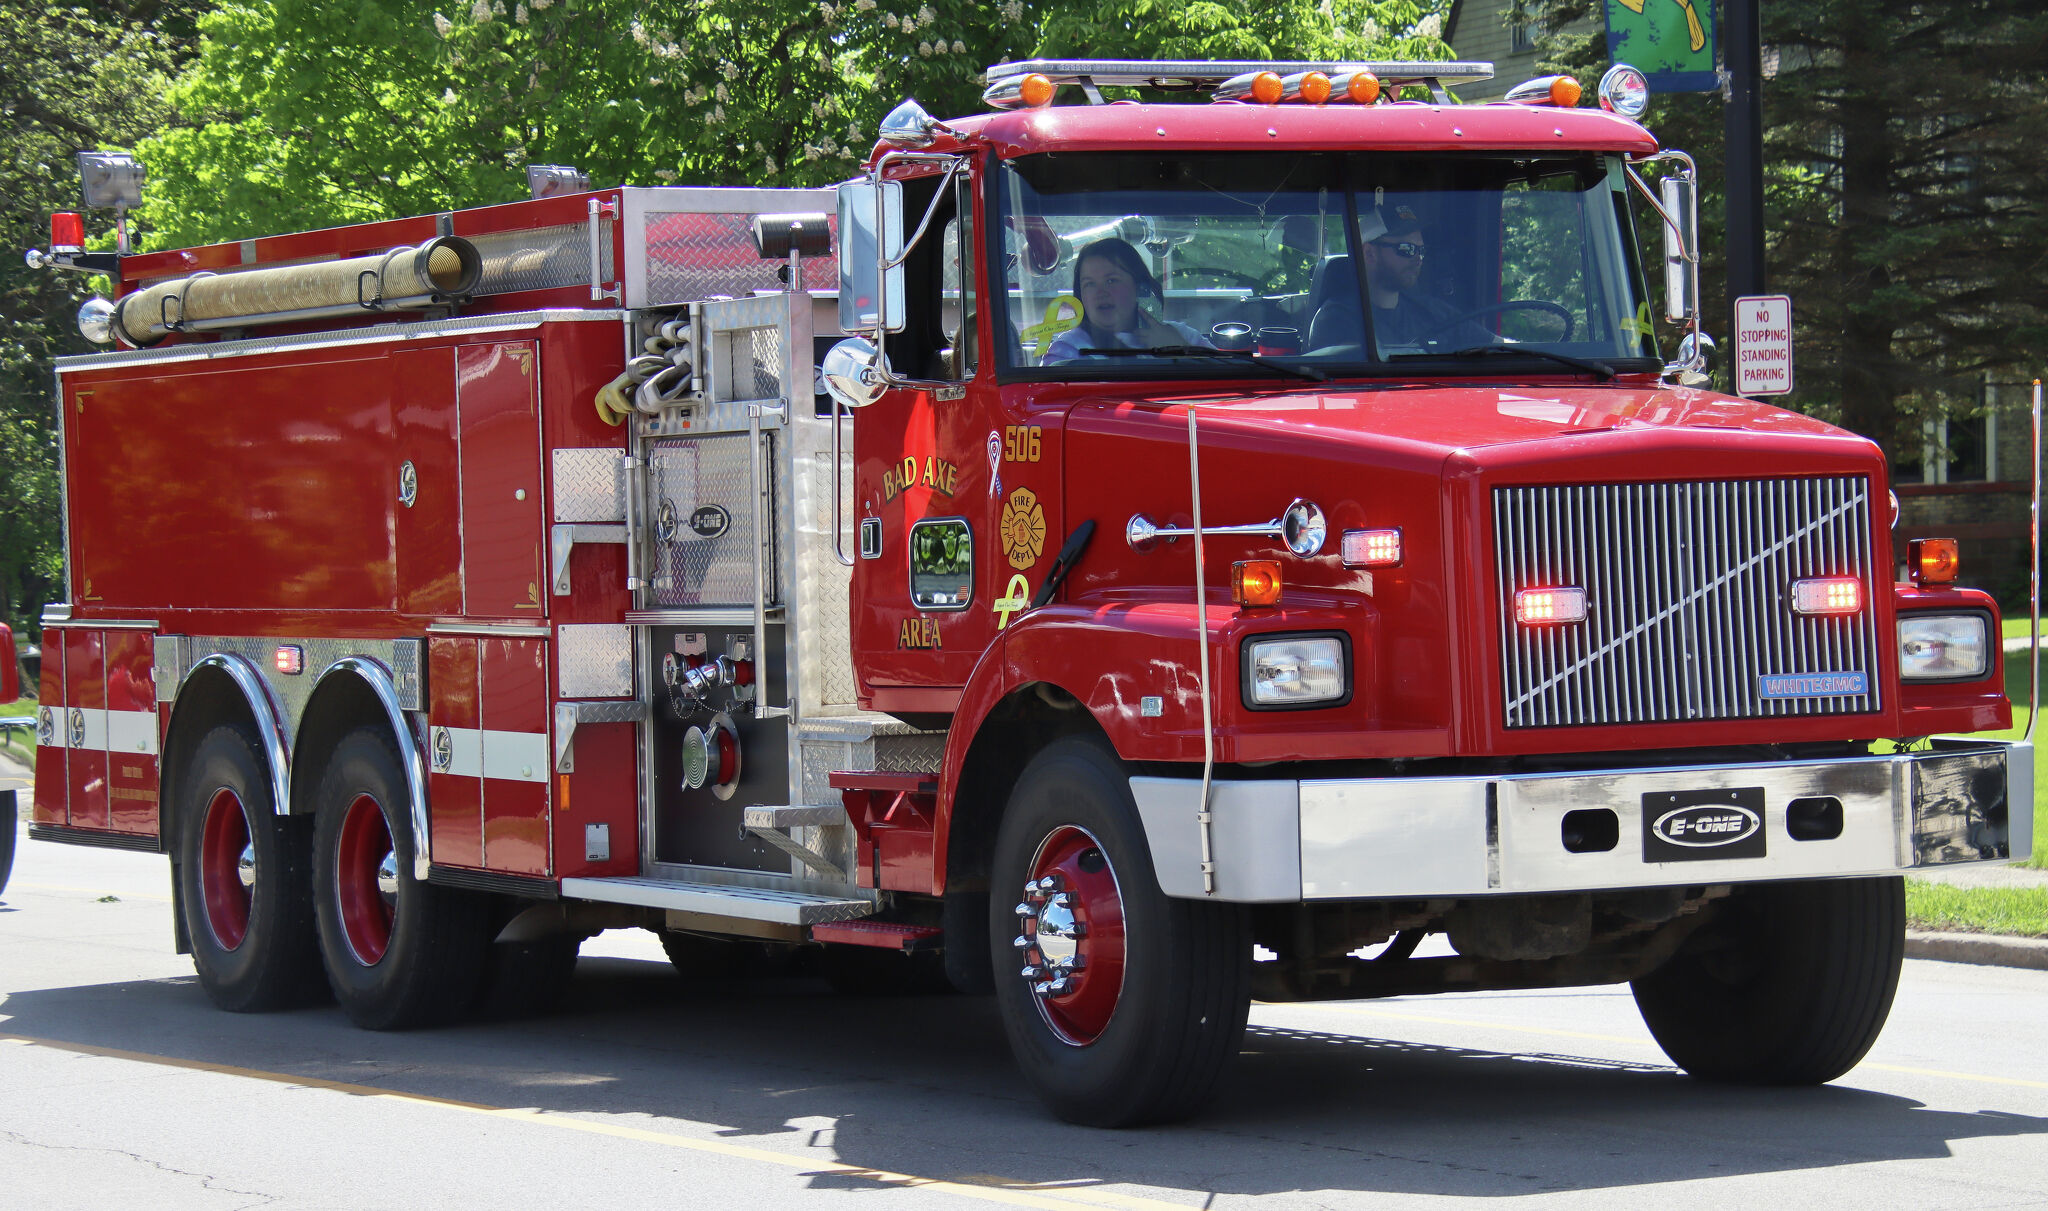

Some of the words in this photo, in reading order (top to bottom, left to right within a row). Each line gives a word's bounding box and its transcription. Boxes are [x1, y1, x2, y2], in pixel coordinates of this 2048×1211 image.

[1756, 310, 1770, 323] NO
[1741, 329, 1787, 343] STOPPING
[1741, 349, 1787, 362] STANDING
[1744, 368, 1784, 381] PARKING
[1004, 425, 1041, 462] 506
[883, 456, 917, 502] BAD
[921, 456, 957, 497] AXE
[1014, 495, 1030, 507] FIRE
[694, 513, 721, 528] E-ONE
[899, 619, 942, 648] AREA
[1766, 676, 1862, 695] WHITEGMC
[1669, 814, 1743, 836] E-ONE
